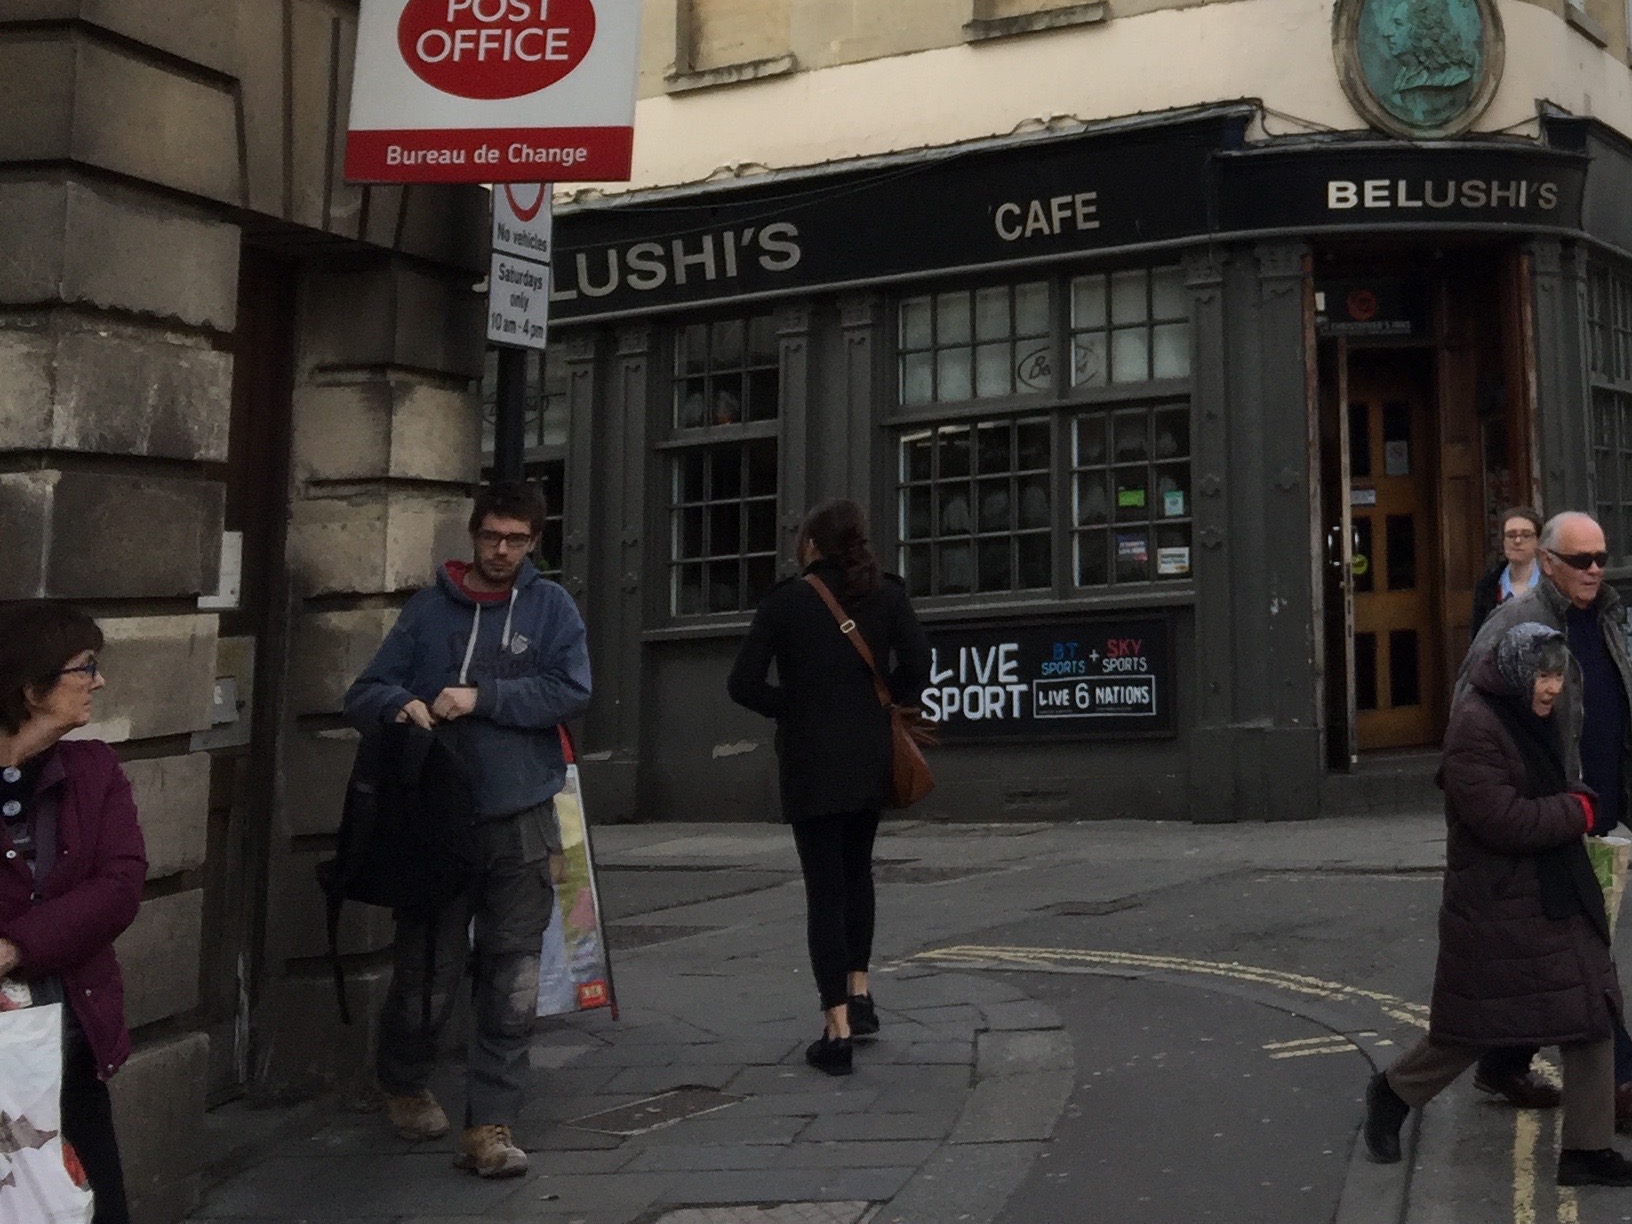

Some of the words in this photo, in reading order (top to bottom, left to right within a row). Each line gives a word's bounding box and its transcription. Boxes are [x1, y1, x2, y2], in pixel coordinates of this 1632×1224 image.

[416, 28, 569, 63] OFFICE
[387, 145, 465, 166] Bureau
[473, 143, 500, 164] de
[507, 143, 588, 167] Change
[1327, 179, 1558, 210] BELUSHI'S
[995, 191, 1100, 241] CAFE
[497, 222, 510, 242] No
[513, 227, 547, 253] vehicles
[472, 223, 801, 301] LUSHI'S
[498, 263, 543, 292] Saturdays
[510, 291, 529, 313] only
[929, 643, 1020, 685] LIVE
[1053, 641, 1079, 660] BT
[1107, 638, 1143, 658] SKY
[1041, 660, 1086, 676] SPORTS
[1102, 657, 1148, 673] SPORTS
[920, 683, 1029, 723] SPORT
[1038, 687, 1070, 707] LIVE
[1074, 683, 1090, 709] 6
[1095, 685, 1150, 705] NATIONS
